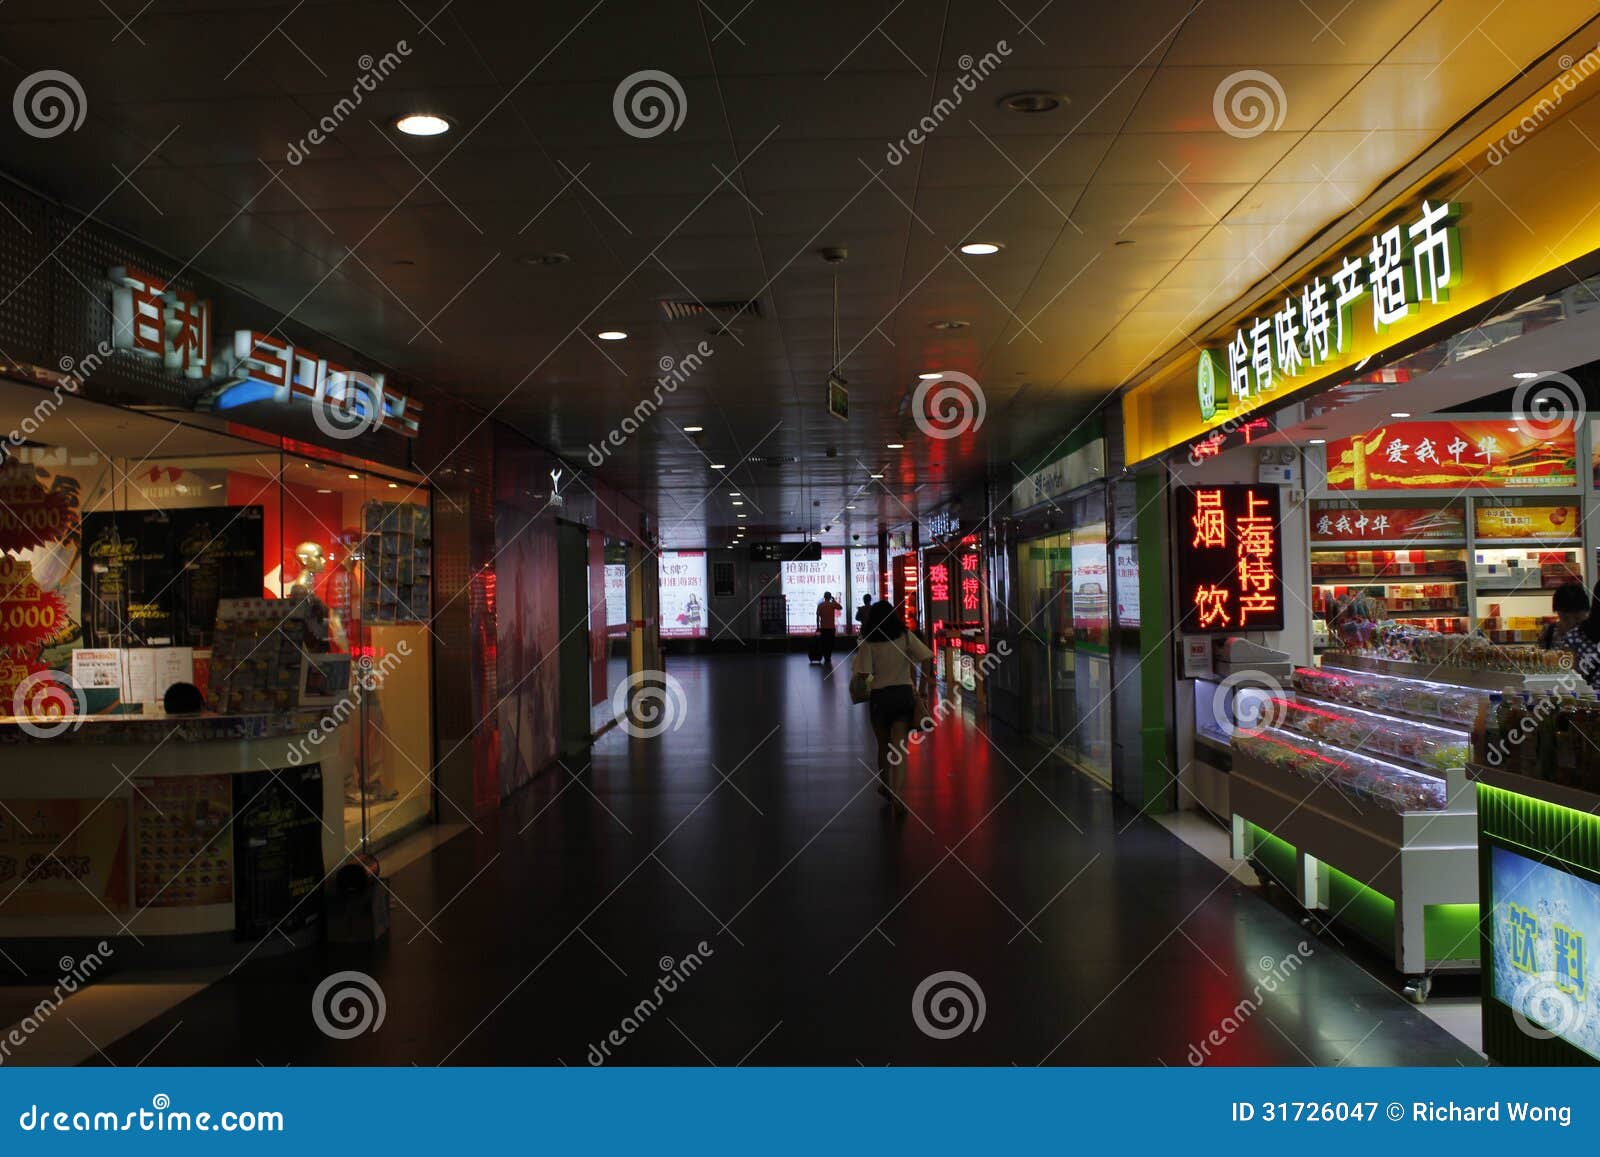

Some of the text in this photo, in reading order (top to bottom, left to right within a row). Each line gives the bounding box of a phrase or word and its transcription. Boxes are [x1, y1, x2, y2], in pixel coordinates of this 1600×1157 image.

[1228, 199, 1451, 400] 哈有味特产超市
[1386, 436, 1501, 464] 爱我中华
[1316, 514, 1391, 536] 爱我中华
[1236, 490, 1276, 627] 上海特产
[930, 564, 949, 601] 珠宝
[0, 605, 55, 632] ,000
[1508, 901, 1588, 1001] 饮料
